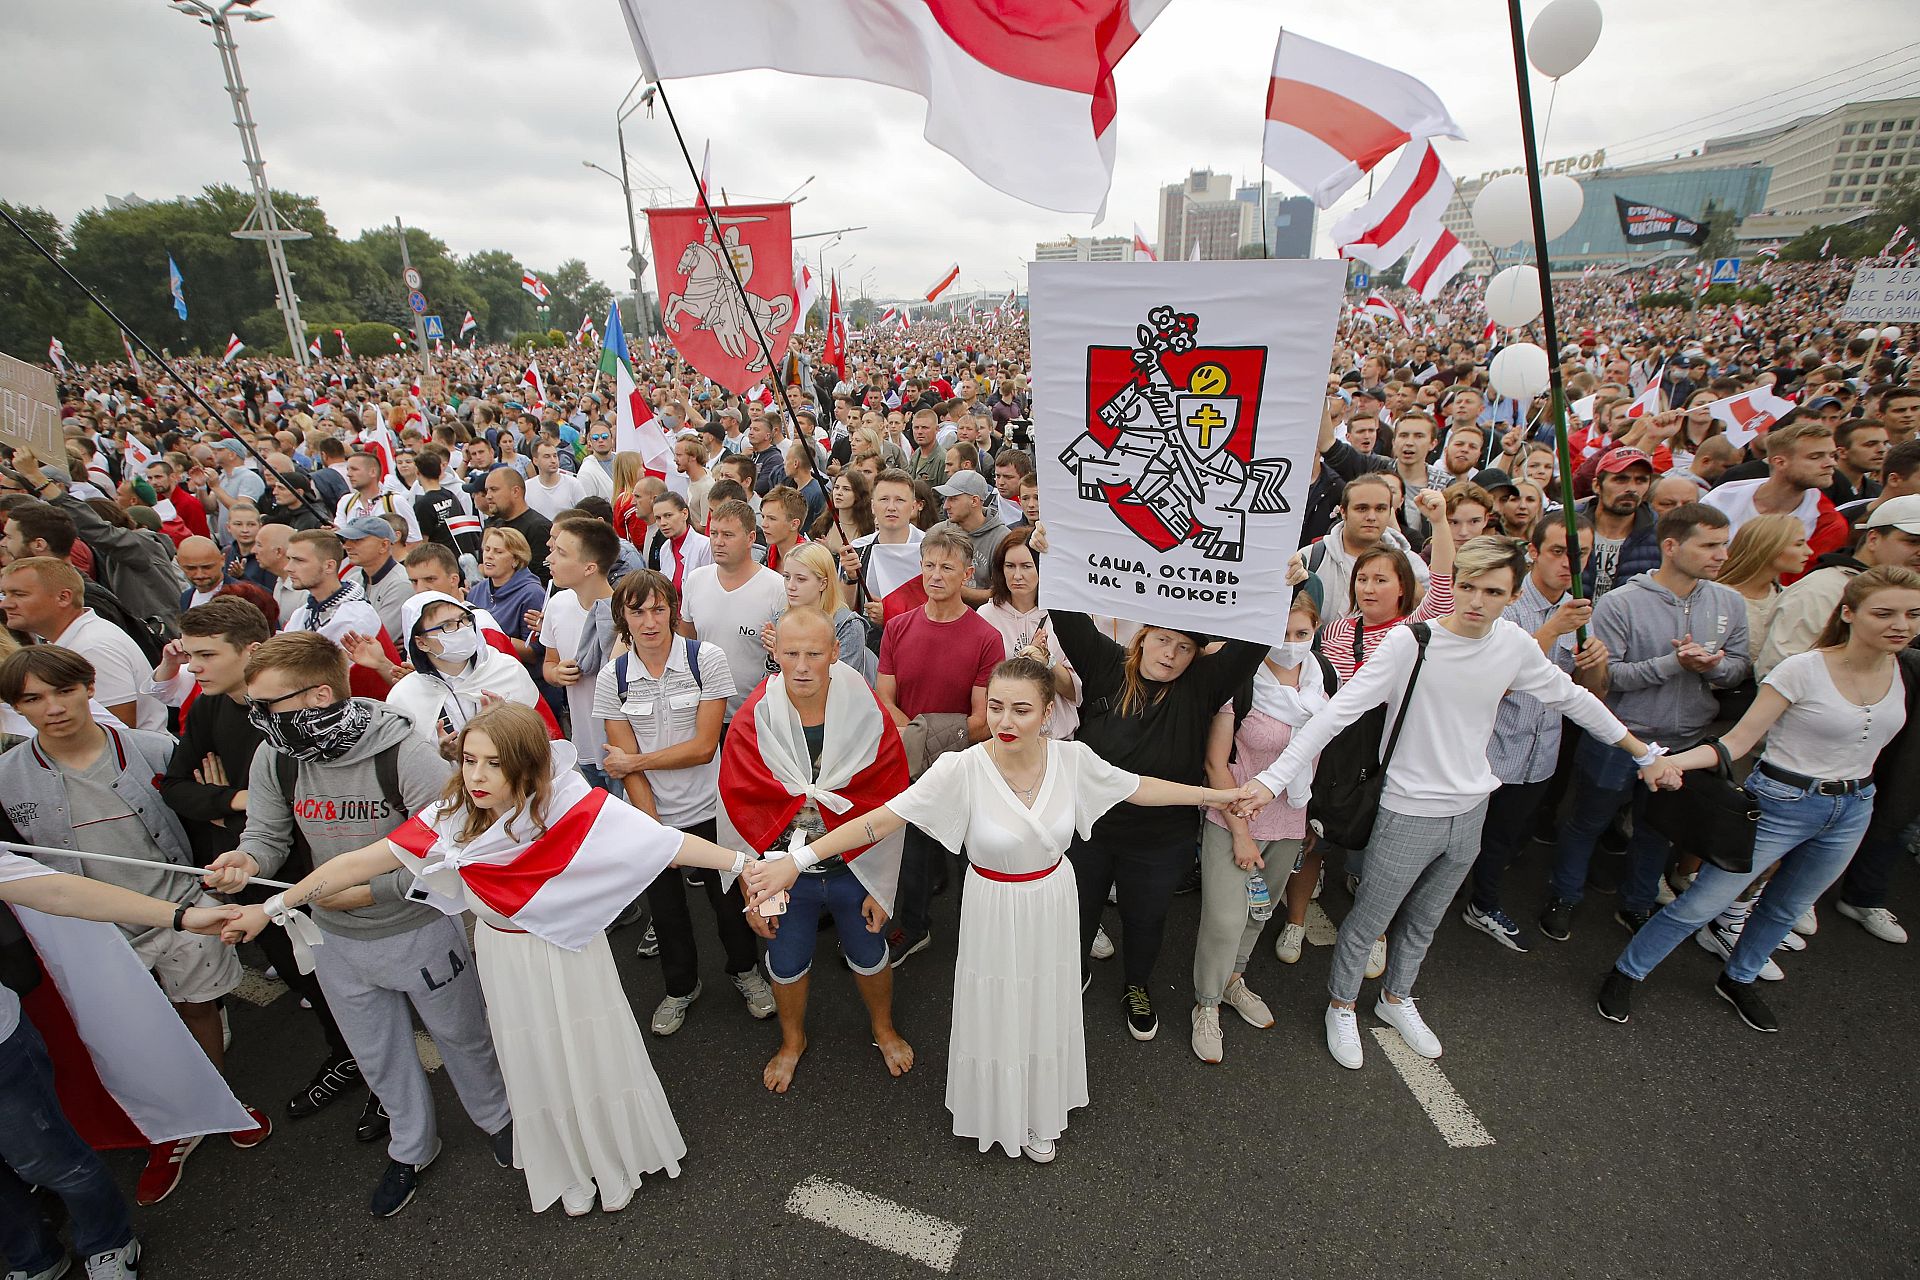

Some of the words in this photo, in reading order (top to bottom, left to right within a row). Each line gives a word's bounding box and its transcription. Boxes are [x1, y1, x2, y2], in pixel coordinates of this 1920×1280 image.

[1857, 271, 1875, 284] ЗА
[1849, 290, 1879, 302] ВСЕ
[1884, 288, 1920, 302] БАЙ
[1088, 553, 1152, 578] САША,
[1159, 564, 1240, 585] ОСТАВЬ
[1088, 572, 1122, 588] НАС
[1135, 580, 1146, 594] В
[1157, 584, 1237, 605] ПОКОЕ!
